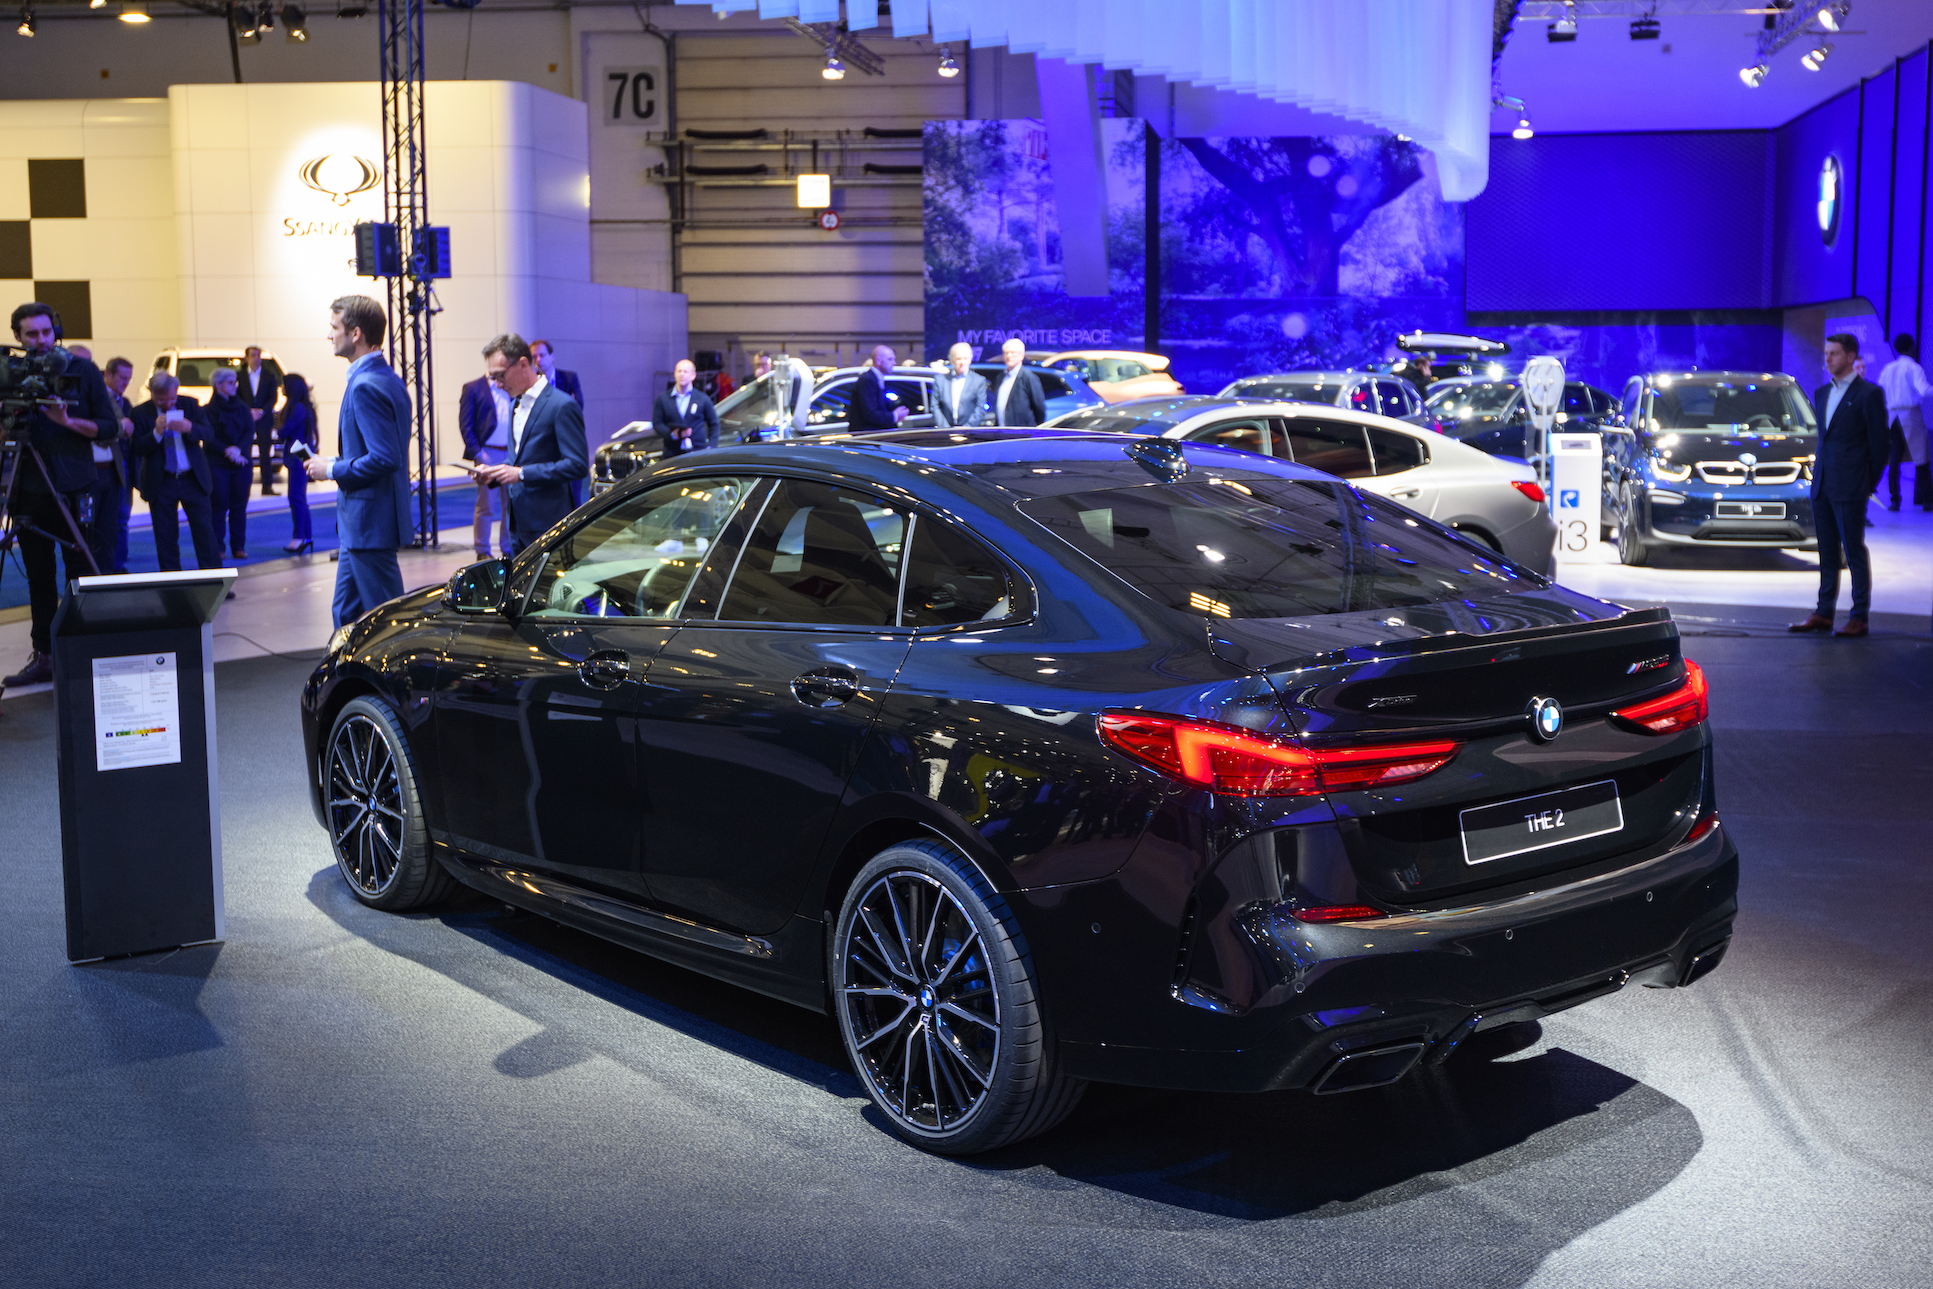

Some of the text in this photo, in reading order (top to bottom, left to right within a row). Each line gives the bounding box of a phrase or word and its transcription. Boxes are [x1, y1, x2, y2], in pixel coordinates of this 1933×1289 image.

[608, 72, 655, 119] 7C
[283, 217, 361, 236] SSANGY
[957, 329, 1113, 345] MY FAVORITE SPACE
[1559, 520, 1588, 552] i3
[1524, 808, 1566, 833] THE 2
